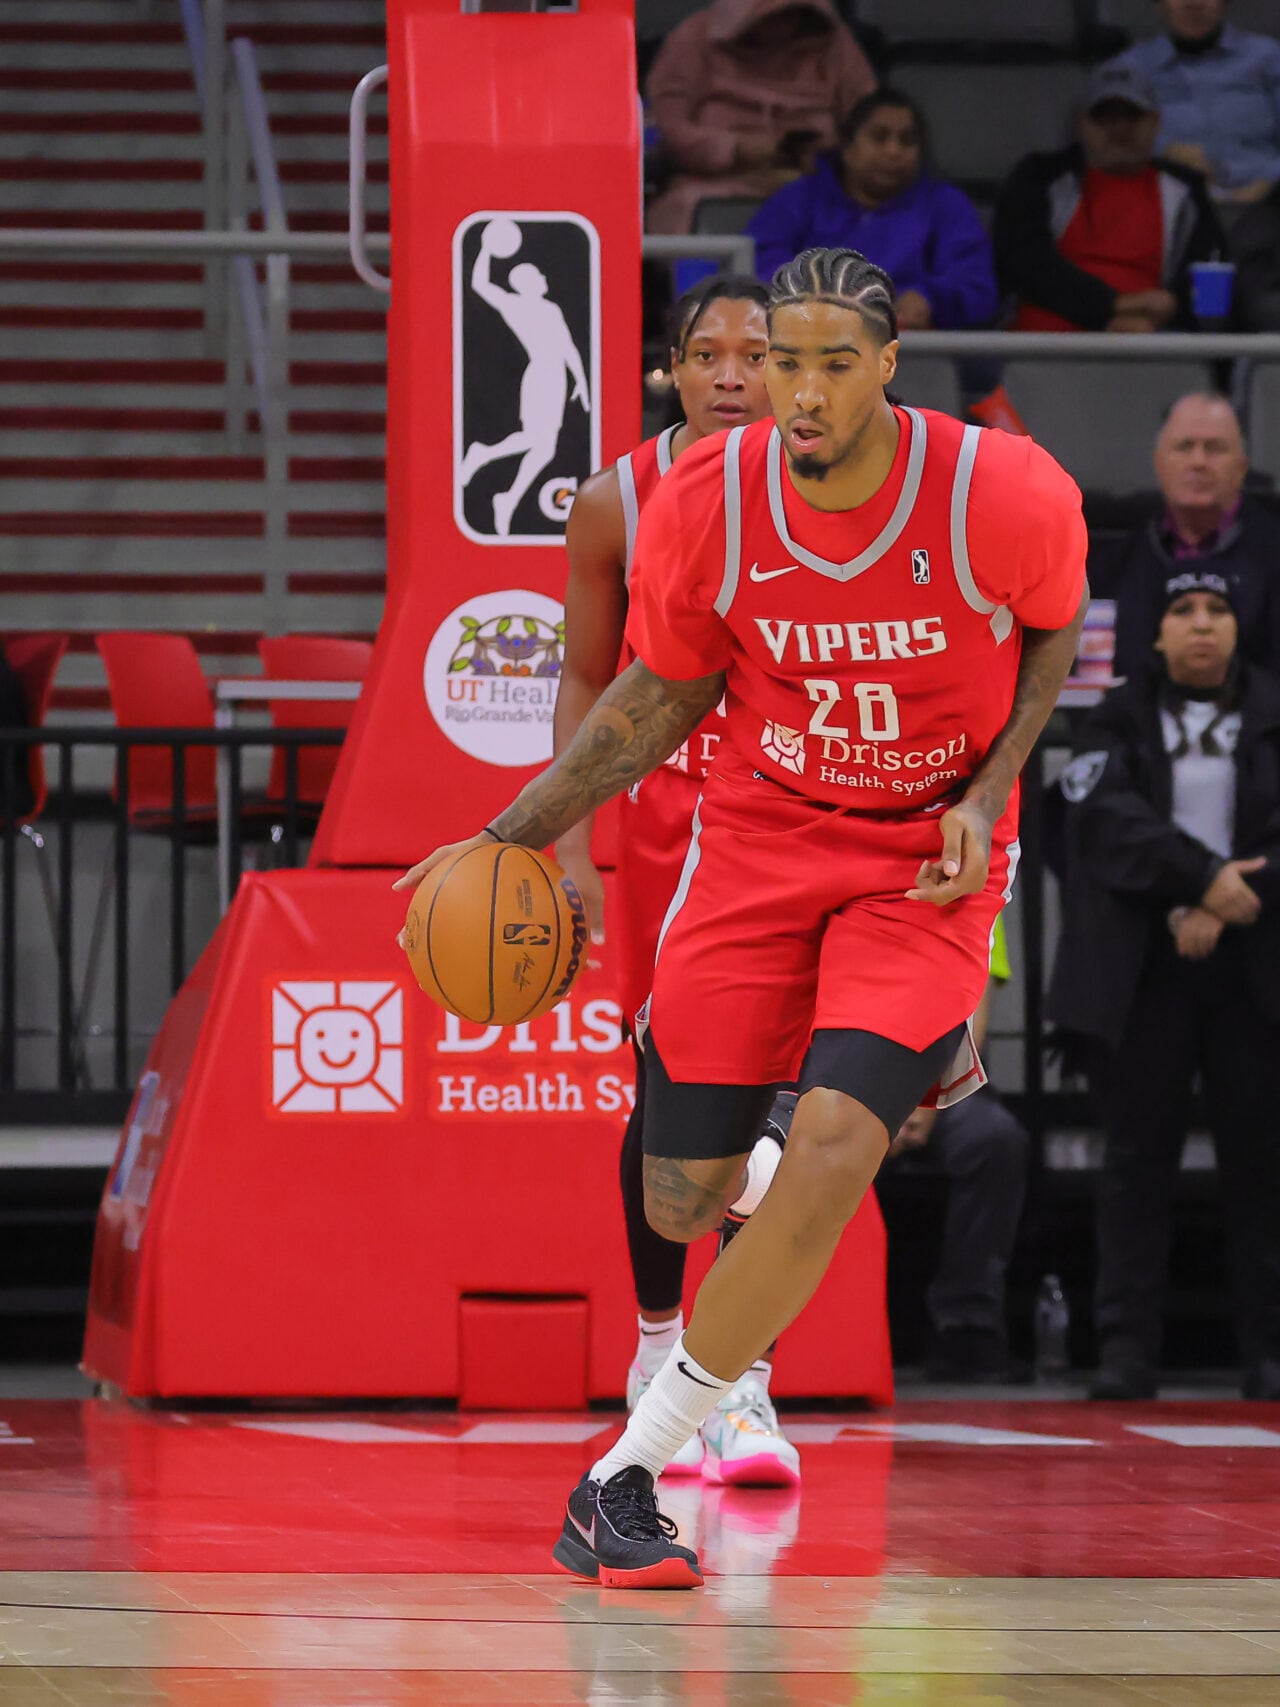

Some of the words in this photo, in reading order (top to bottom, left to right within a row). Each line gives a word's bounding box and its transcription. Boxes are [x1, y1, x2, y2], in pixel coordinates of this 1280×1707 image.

[753, 616, 948, 664] VIPERS
[447, 680, 484, 701] UT
[490, 680, 552, 703] Heal
[803, 678, 901, 741] 20
[471, 706, 532, 723] Grande
[820, 733, 967, 772] Driscoll
[819, 766, 886, 789] Health
[891, 769, 957, 795] System
[436, 999, 622, 1052] Dris
[437, 1072, 585, 1112] Health
